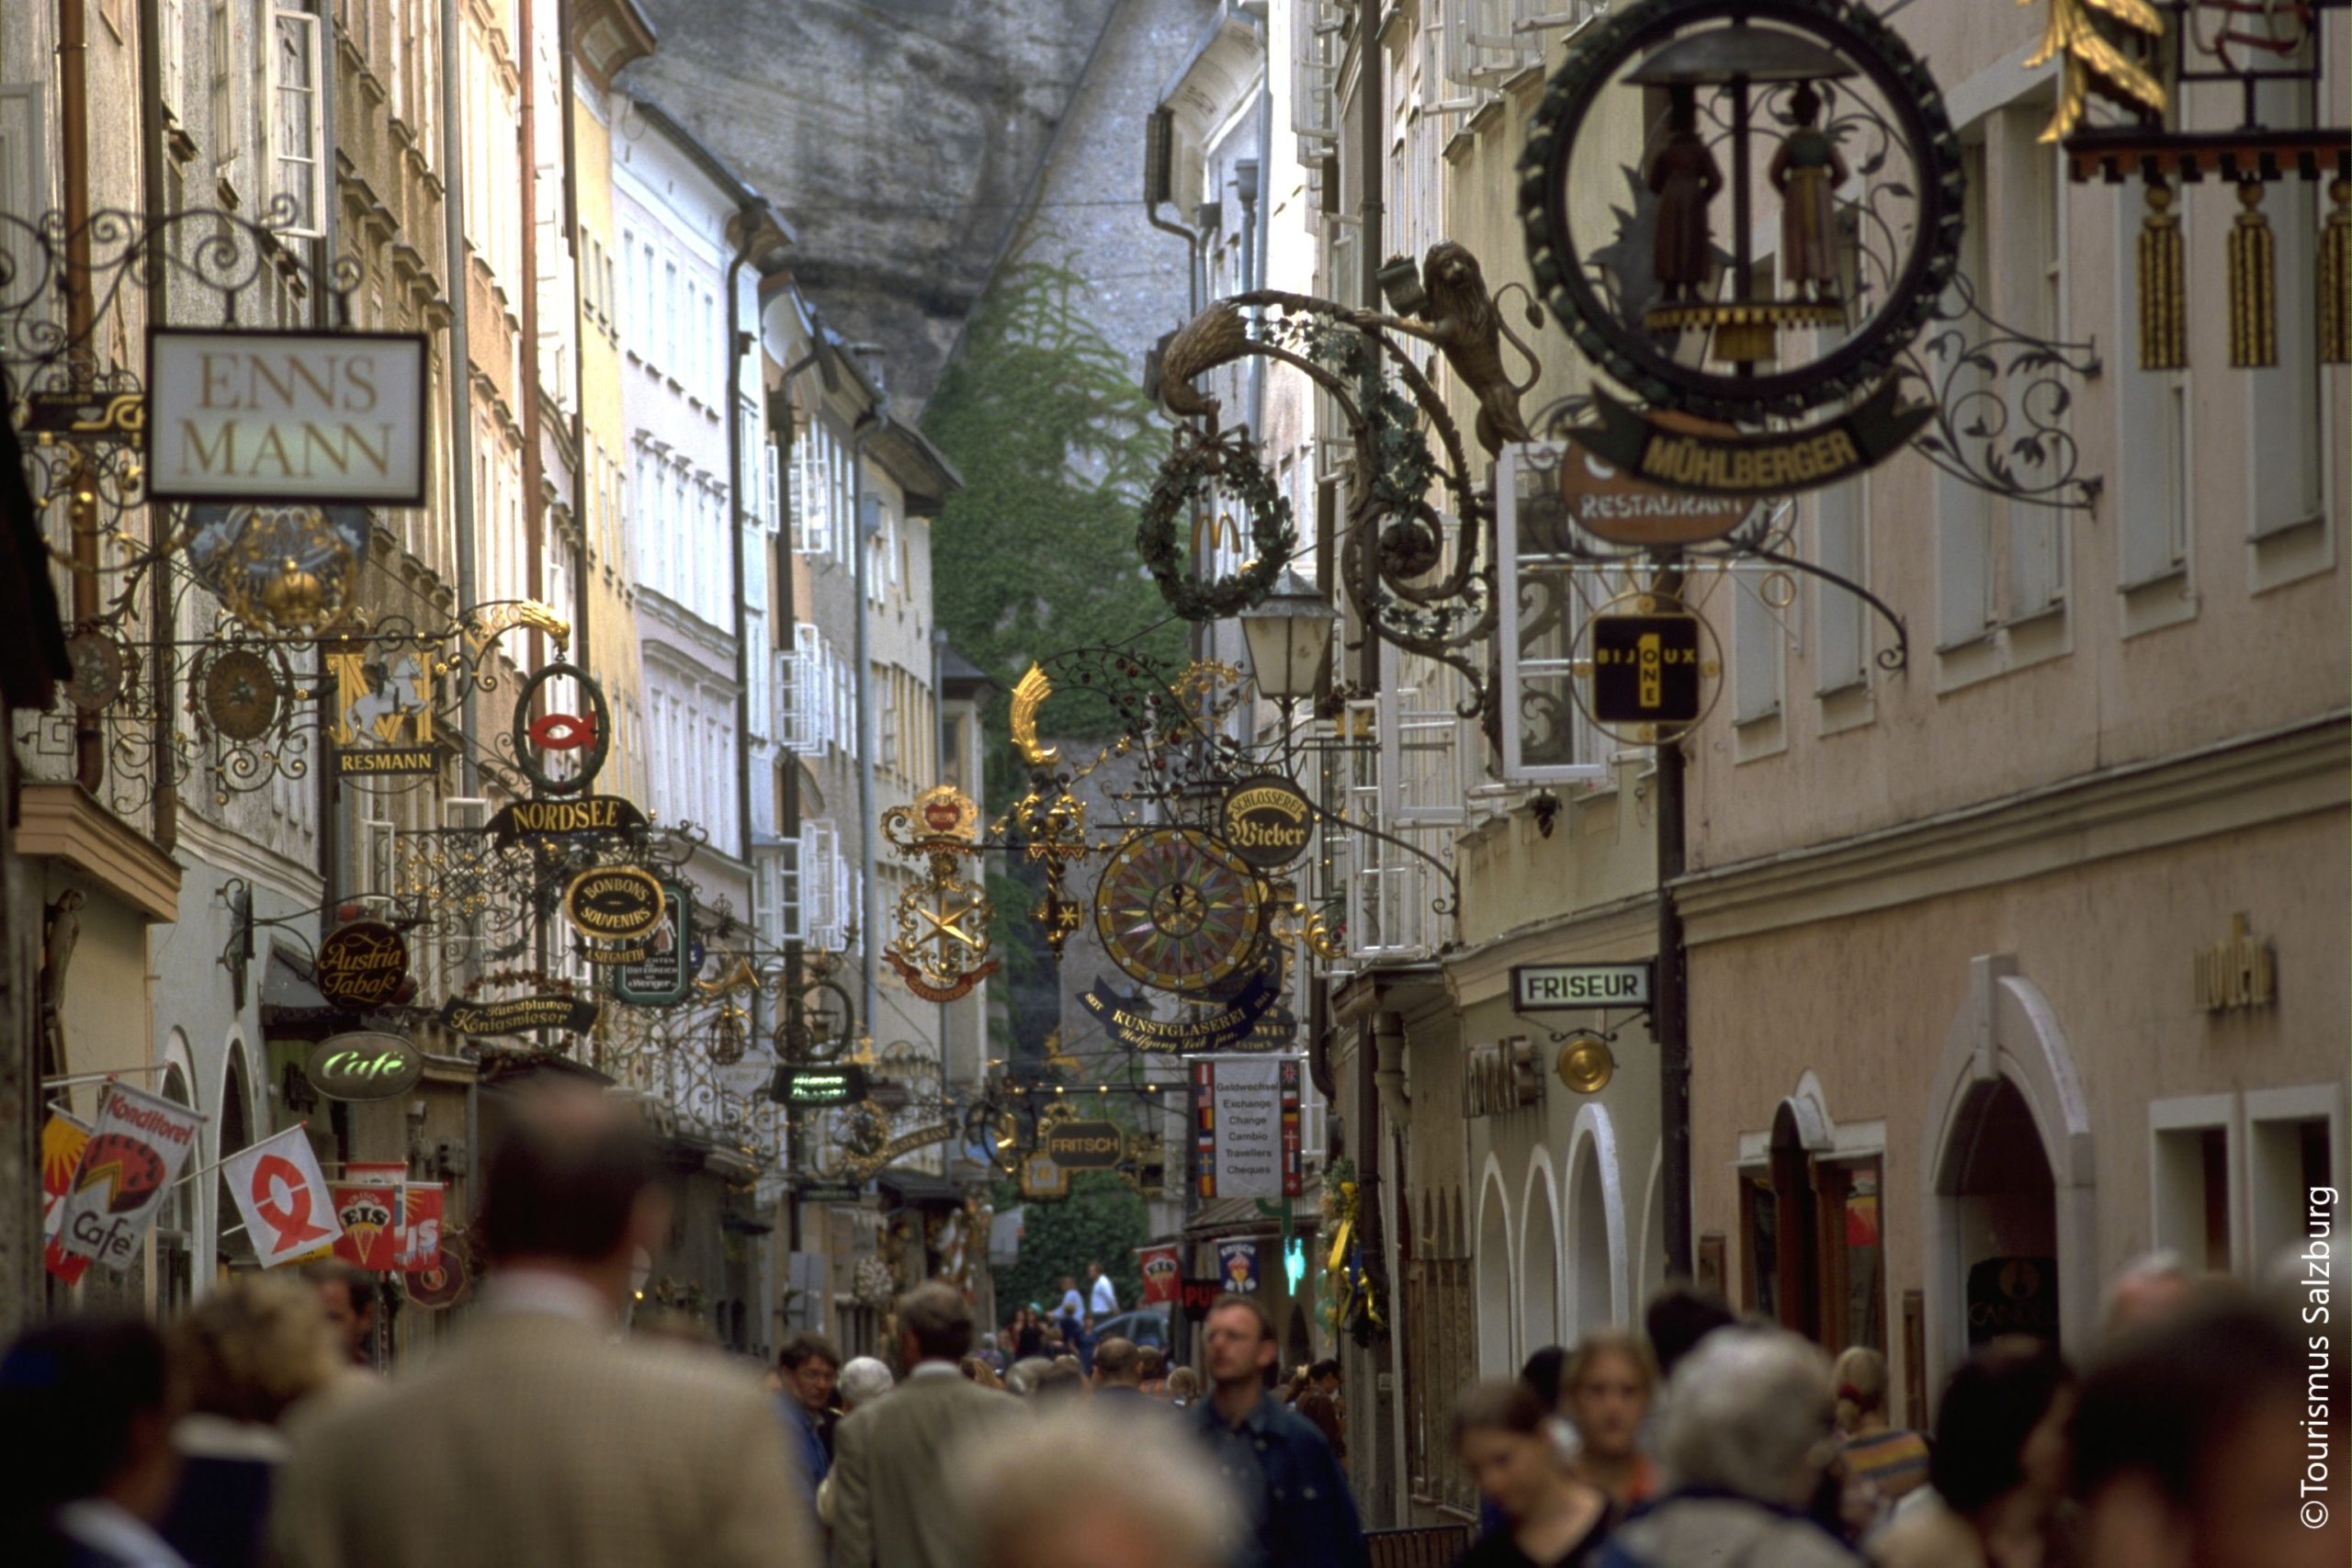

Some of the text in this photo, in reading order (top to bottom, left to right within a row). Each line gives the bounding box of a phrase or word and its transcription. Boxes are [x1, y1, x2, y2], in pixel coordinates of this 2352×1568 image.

[199, 352, 379, 412] ENNS
[180, 418, 395, 479] MANN
[1643, 428, 1860, 489] MÜHLBERGER
[342, 754, 432, 771] RESMANN
[1231, 790, 1304, 816] SCHLOSSEREI
[512, 800, 620, 833] NORDSEE
[1227, 818, 1305, 847] Wieber
[583, 877, 649, 901] BONBONS
[581, 907, 650, 929] SOUVENIRS
[320, 933, 401, 971] Austria
[323, 967, 401, 1003] Tabak
[1528, 974, 1638, 999] FRISEUR
[1085, 992, 1103, 1011] SEIT
[1113, 1008, 1247, 1037] KUNSTGLASEREI
[1216, 1082, 1279, 1092] Geldwechsel
[1223, 1100, 1272, 1109] Exchange
[1228, 1116, 1267, 1126] Change
[1051, 1137, 1119, 1153] FRITSCH
[1228, 1132, 1268, 1141] Cambio
[1226, 1148, 1272, 1157] Travellers
[1227, 1166, 1271, 1175] Cheques
[341, 1207, 389, 1227] EIS
[1185, 1286, 1220, 1308] PU
